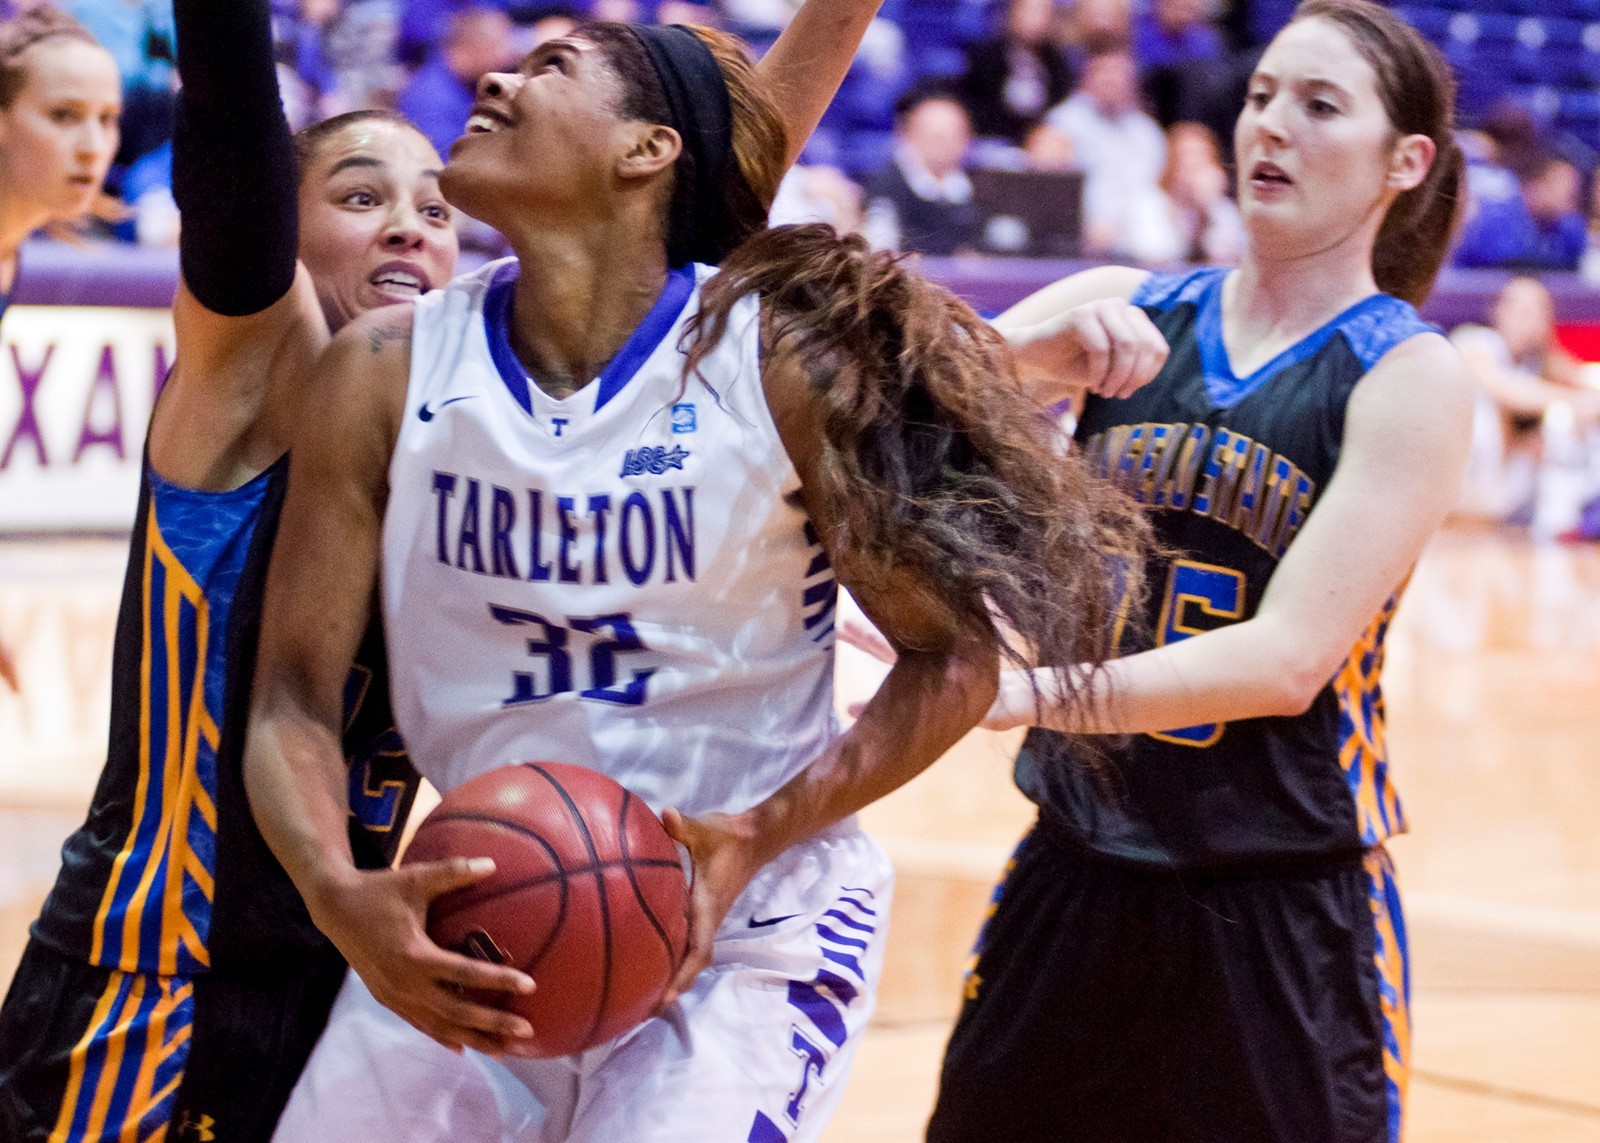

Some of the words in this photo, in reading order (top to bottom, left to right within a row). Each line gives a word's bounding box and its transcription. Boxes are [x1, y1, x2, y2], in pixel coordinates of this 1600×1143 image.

[551, 417, 569, 438] T
[431, 469, 696, 588] TARLETON
[488, 602, 656, 709] 32
